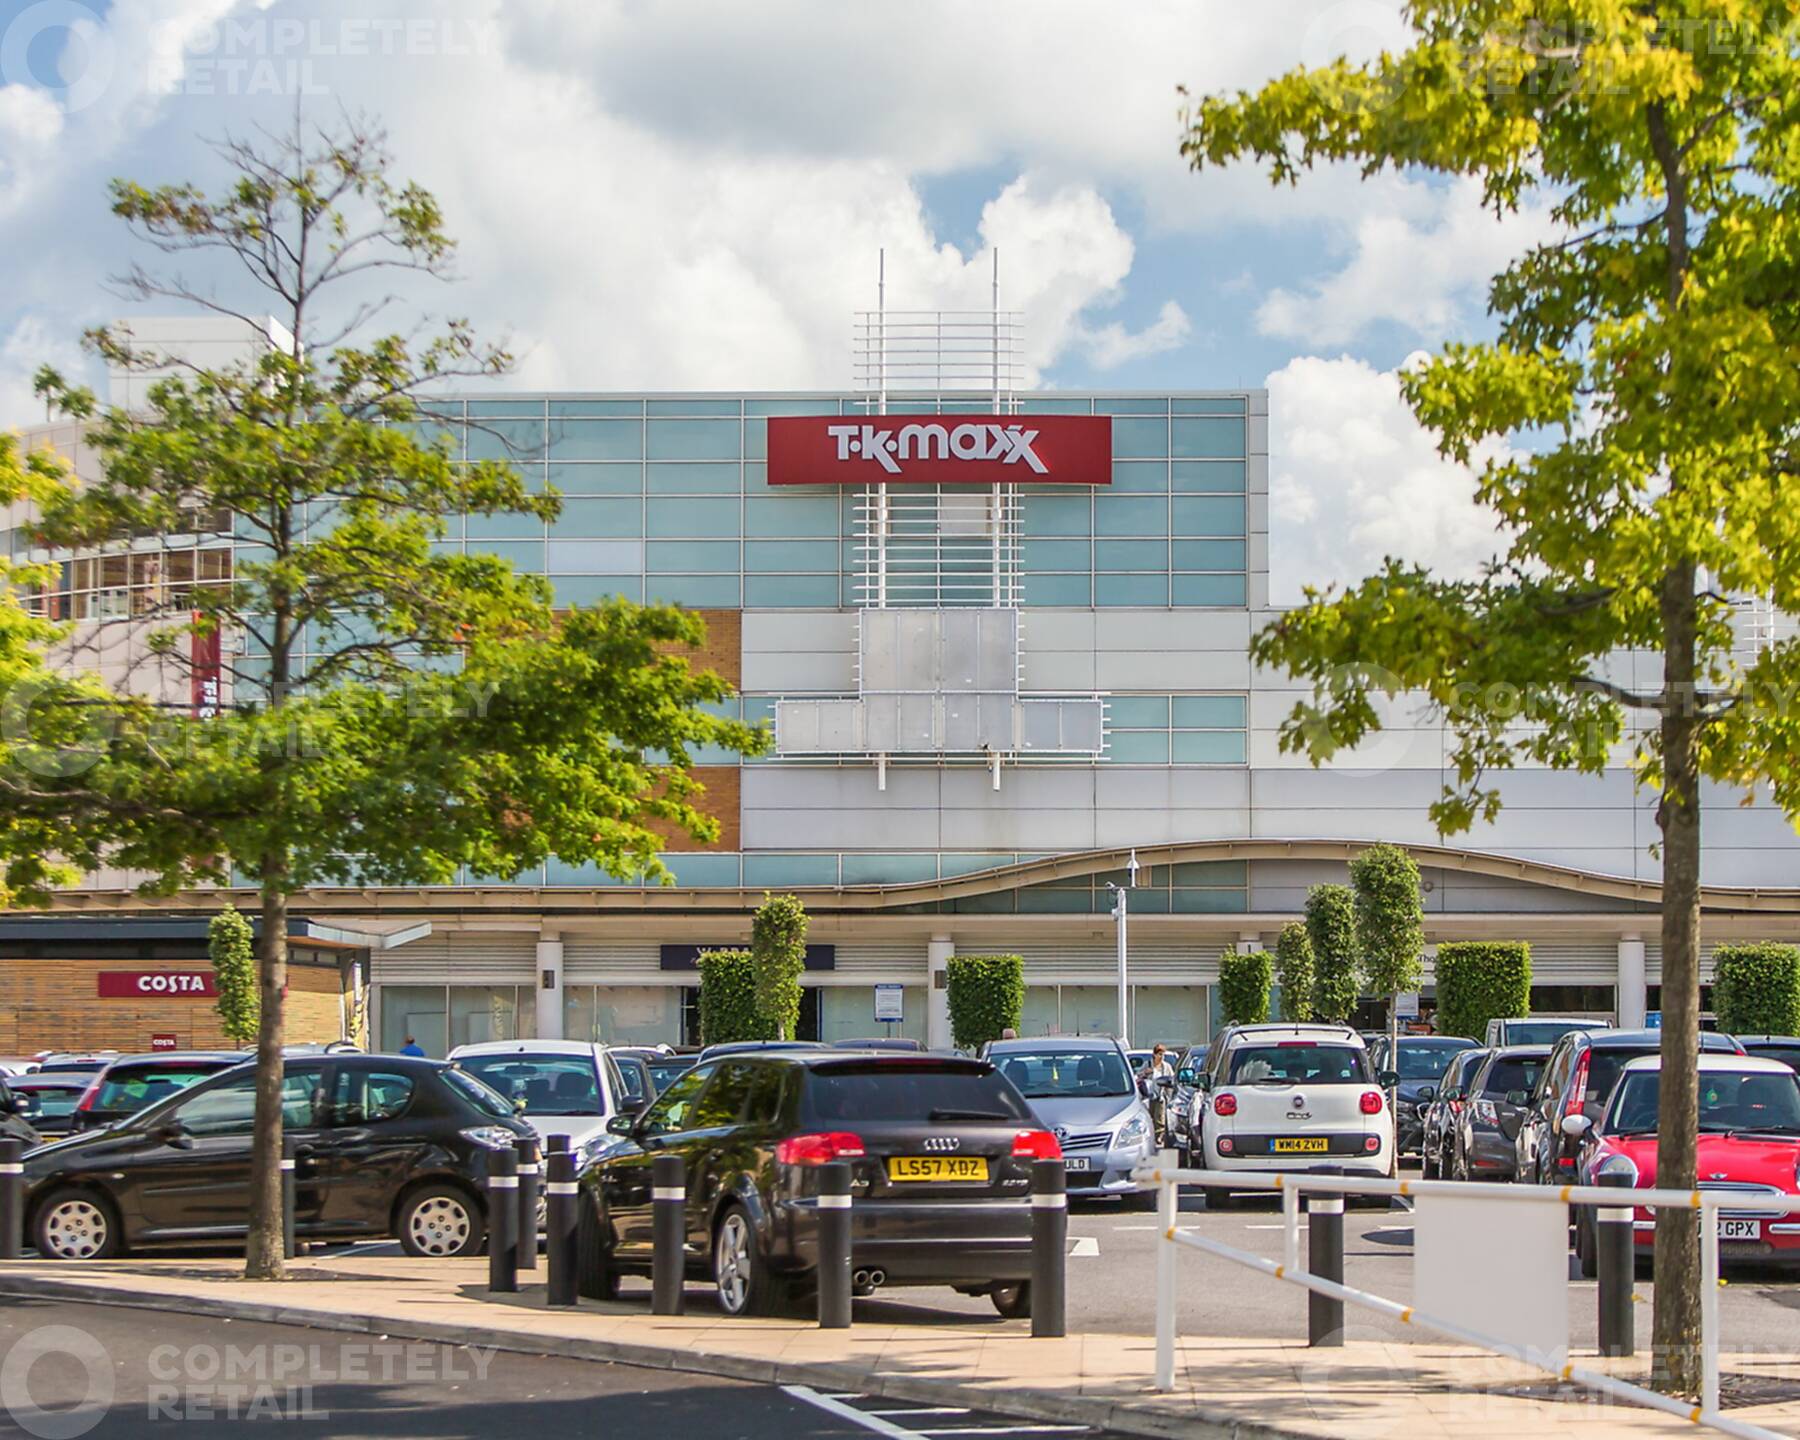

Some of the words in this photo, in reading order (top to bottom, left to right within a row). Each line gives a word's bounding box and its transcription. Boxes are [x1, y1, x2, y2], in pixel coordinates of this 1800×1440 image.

[137, 975, 205, 993] COSTA
[153, 1038, 175, 1046] COSTA
[1303, 1139, 1324, 1150] ZVH
[897, 1159, 942, 1176] LS57
[1725, 1221, 1754, 1237] GPX
